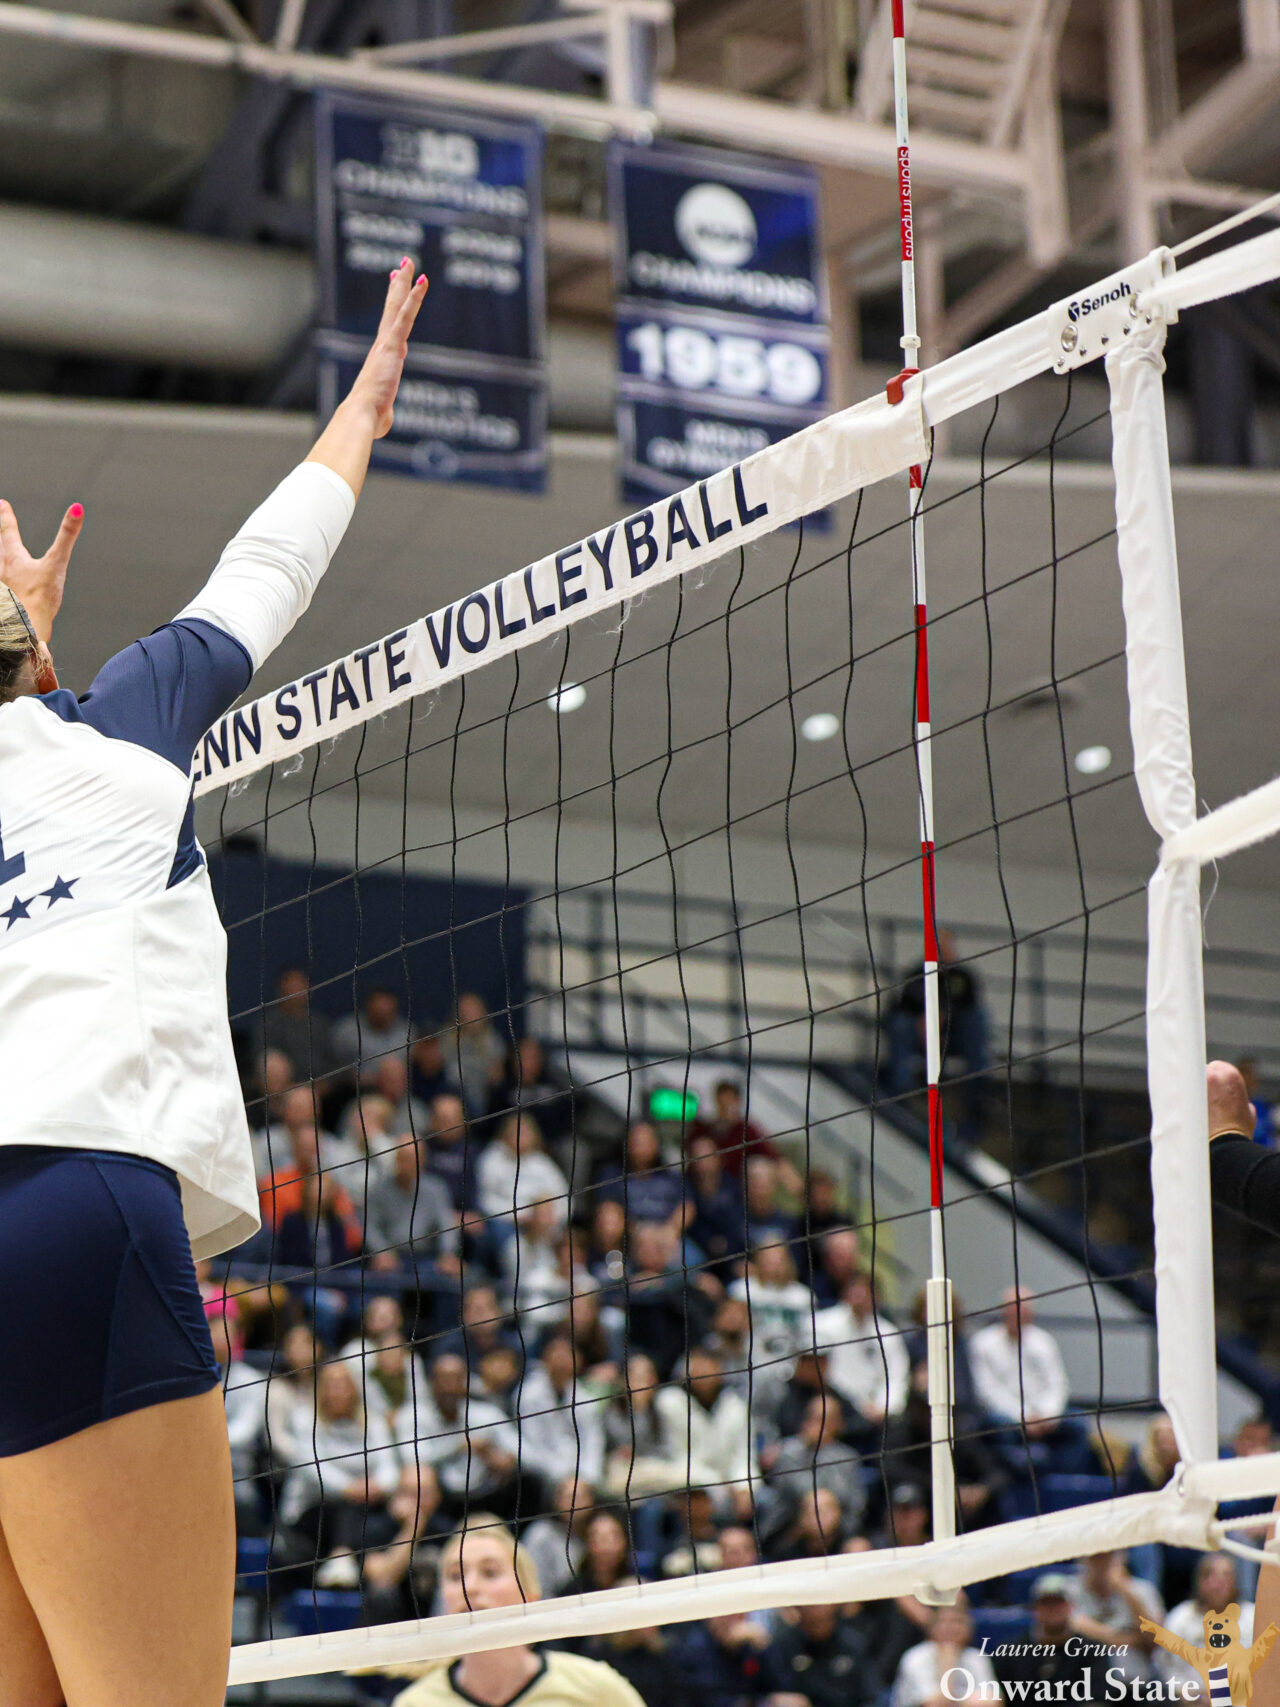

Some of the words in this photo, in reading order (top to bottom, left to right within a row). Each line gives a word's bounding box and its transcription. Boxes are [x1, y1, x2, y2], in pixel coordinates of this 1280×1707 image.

[629, 250, 817, 315] CHAMPIONS
[1081, 282, 1131, 316] Senoh
[626, 322, 821, 405] 1959
[276, 630, 412, 740] STATE
[425, 464, 769, 669] VOLLEYBALL
